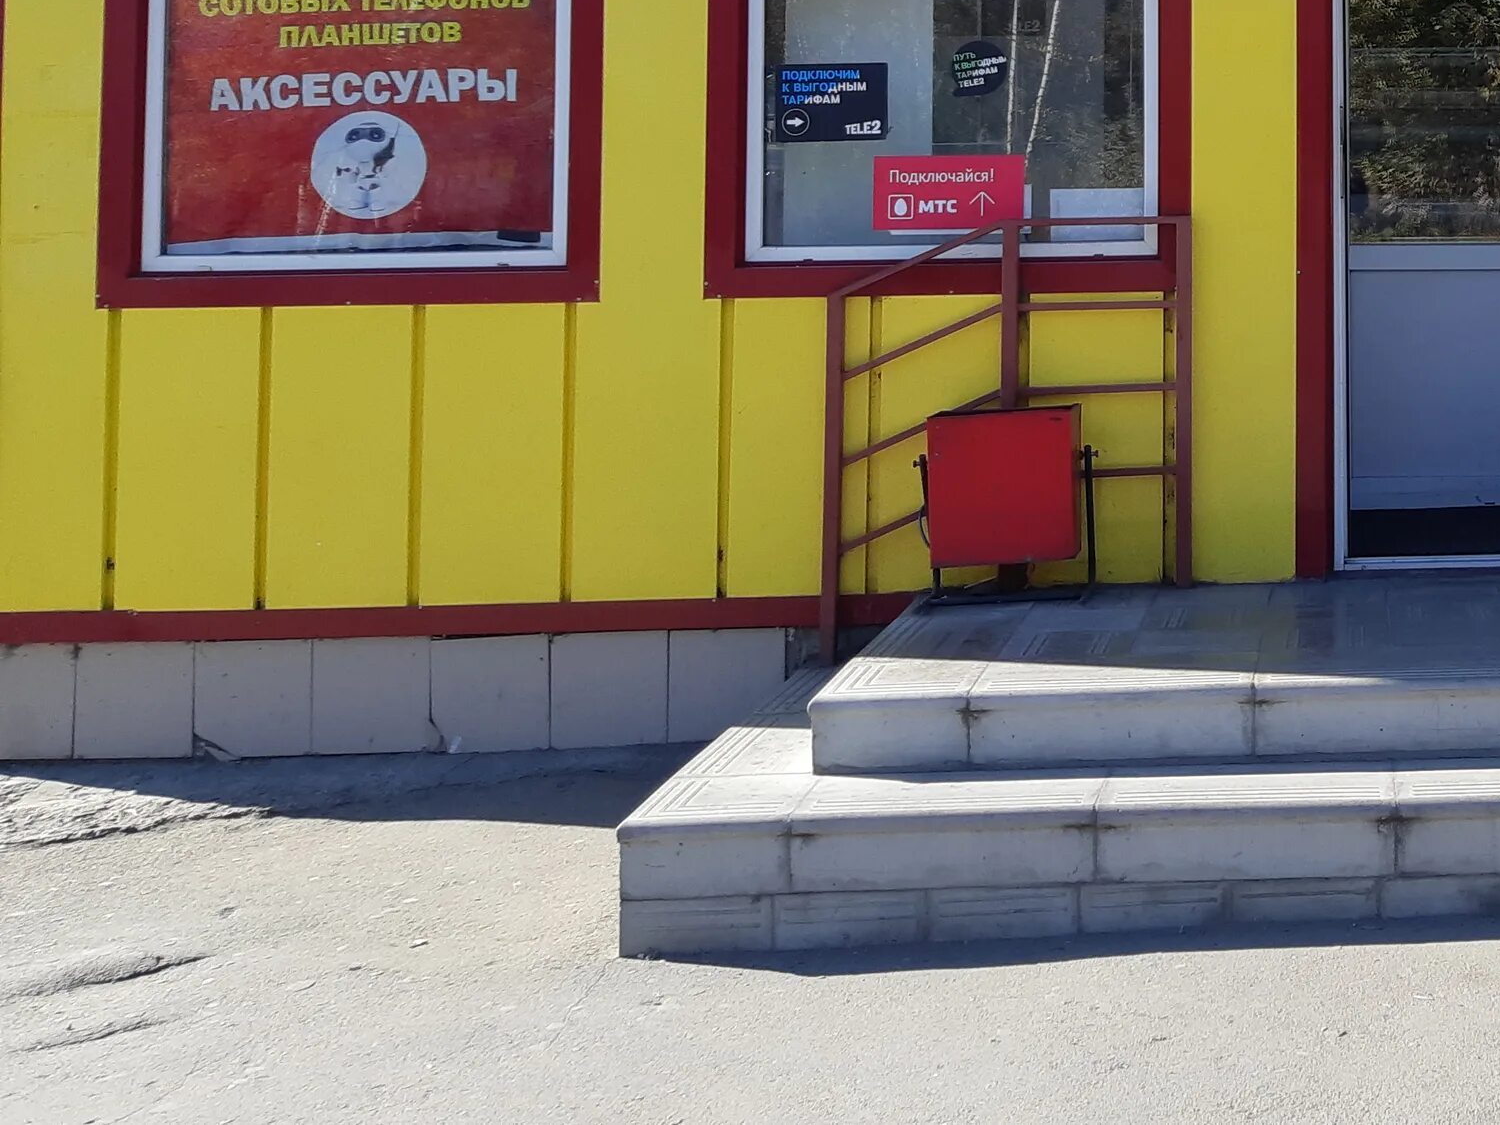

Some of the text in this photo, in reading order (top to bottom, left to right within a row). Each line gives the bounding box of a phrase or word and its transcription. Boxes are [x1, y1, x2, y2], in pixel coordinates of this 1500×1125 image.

[278, 21, 463, 49] ПЛАНШЕТОВ
[953, 52, 976, 61] ПУТЬ
[782, 69, 860, 81] ПОДКЛЮЧИМ
[956, 66, 998, 79] ТАРИФАМ
[782, 82, 867, 93] К ВЫГОДНЫМ
[958, 77, 985, 88] TELE2
[210, 68, 518, 111] АКСЕССУАРЫ
[783, 94, 840, 105] ТАРИФАМ
[845, 120, 881, 135] TELE2
[889, 168, 994, 185] Подключайся!
[918, 199, 957, 213] МТС
